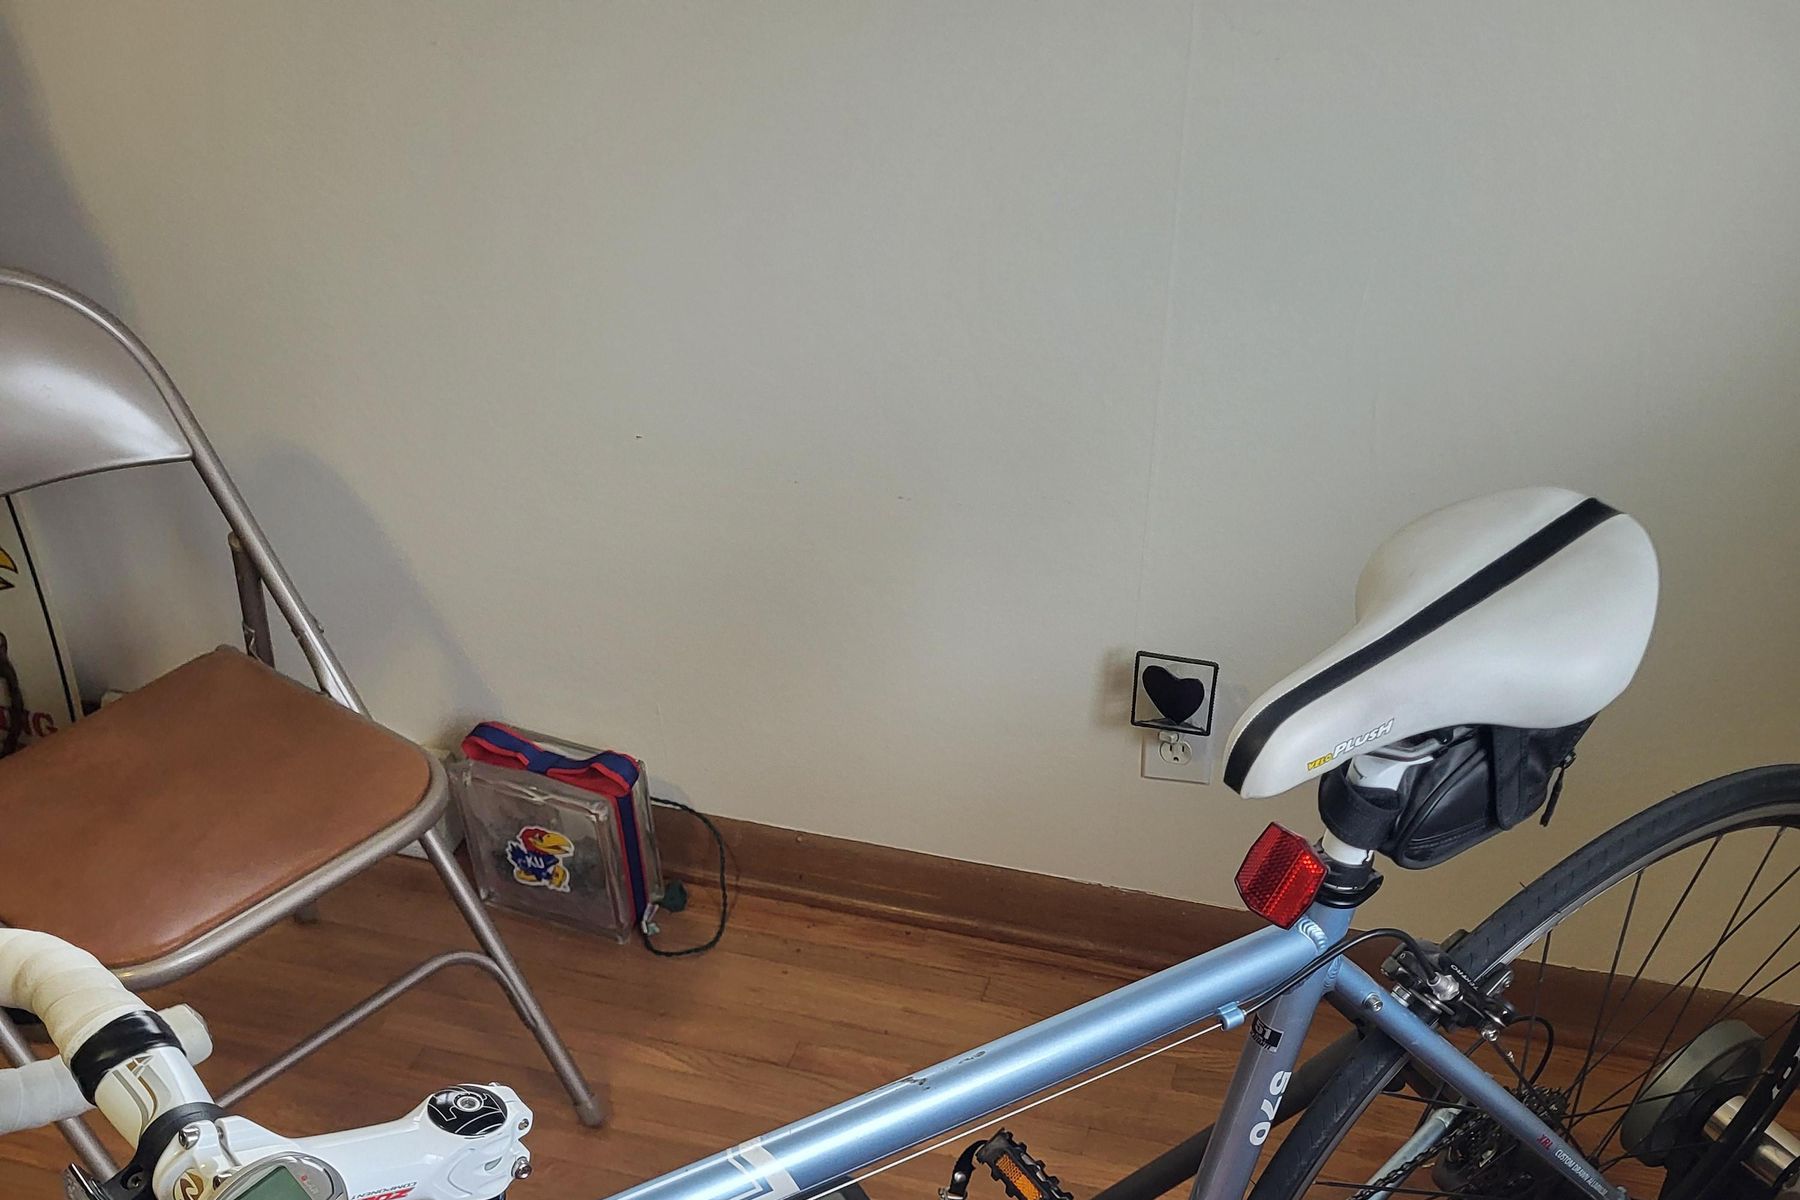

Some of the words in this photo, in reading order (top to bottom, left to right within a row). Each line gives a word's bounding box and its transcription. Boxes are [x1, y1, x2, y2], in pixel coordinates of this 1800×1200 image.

[1307, 753, 1334, 771] VELO
[1332, 717, 1395, 760] PLUSH
[525, 854, 546, 869] KU
[1450, 964, 1479, 991] TEKTRO
[1253, 1018, 1273, 1041] 51
[1249, 1069, 1293, 1147] 570
[1554, 1148, 1577, 1170] CUSTOM
